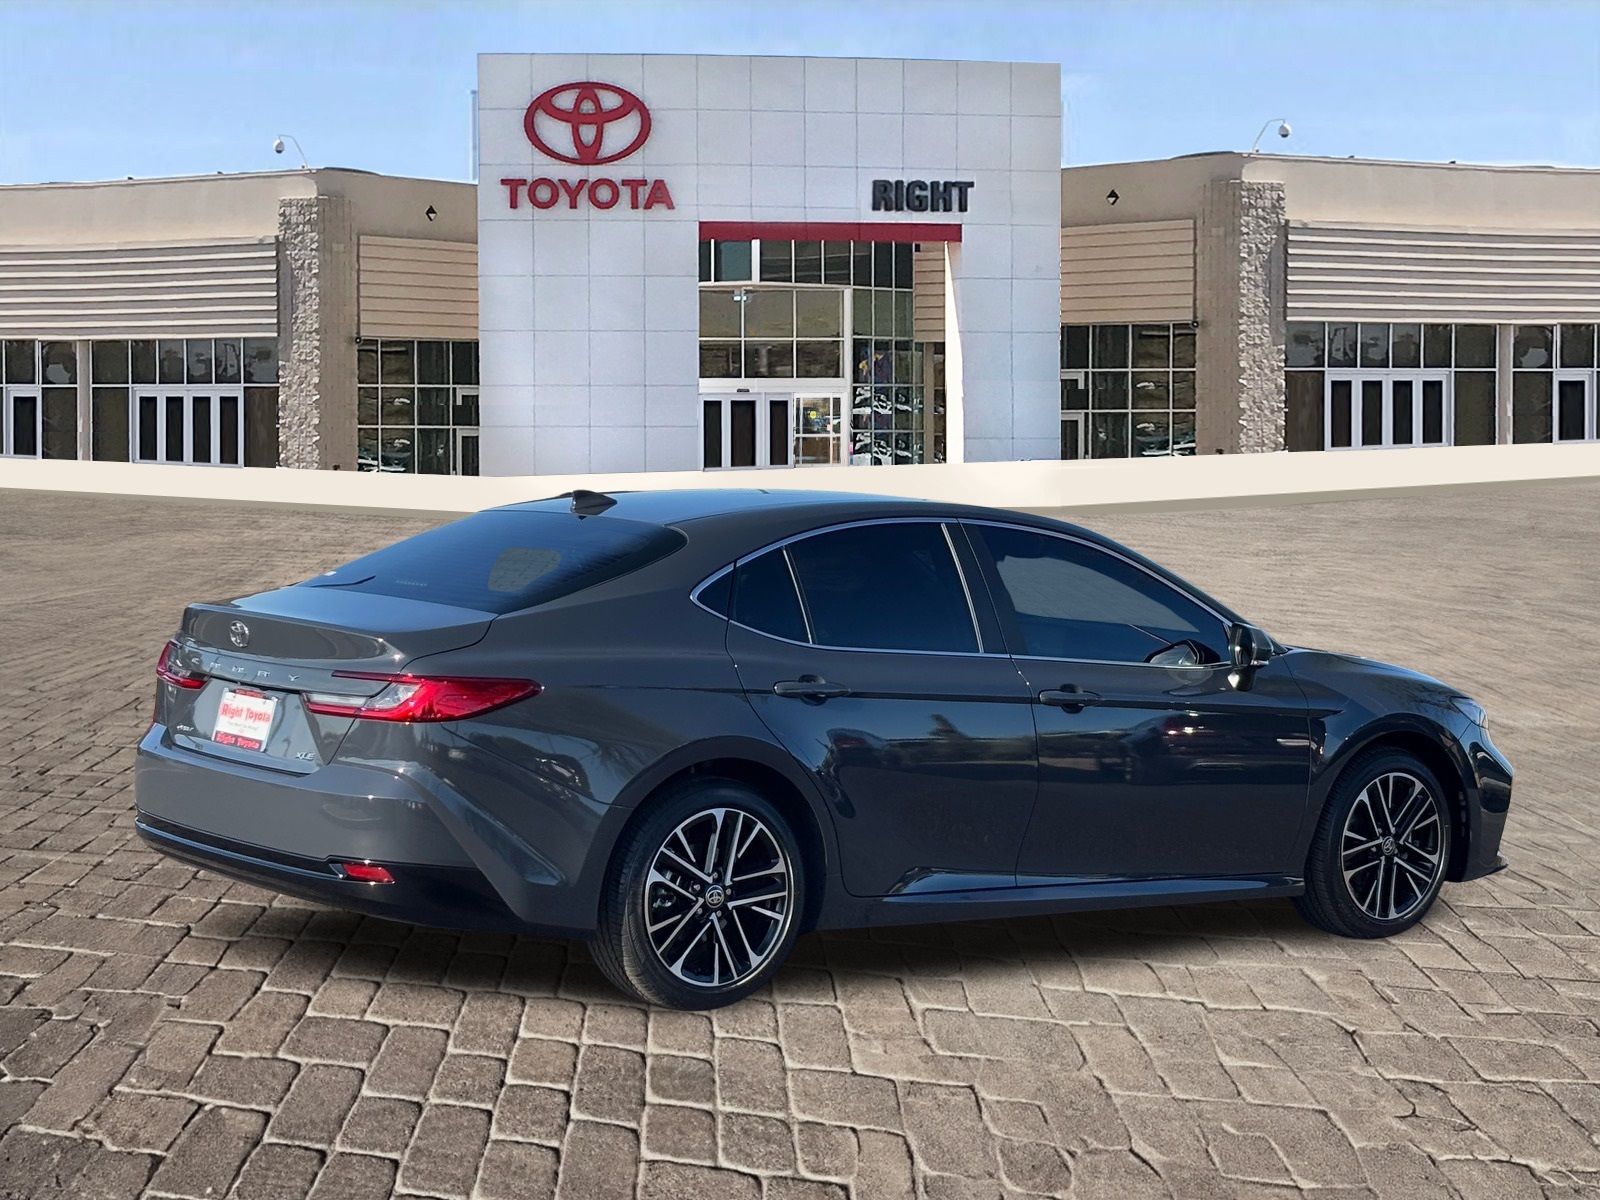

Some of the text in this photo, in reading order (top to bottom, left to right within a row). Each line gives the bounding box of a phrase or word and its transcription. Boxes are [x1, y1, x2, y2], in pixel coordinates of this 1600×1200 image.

[500, 177, 675, 210] TOYOTA
[871, 179, 974, 213] RIGHT
[221, 703, 271, 723] Right Toyota
[295, 751, 316, 761] XLE
